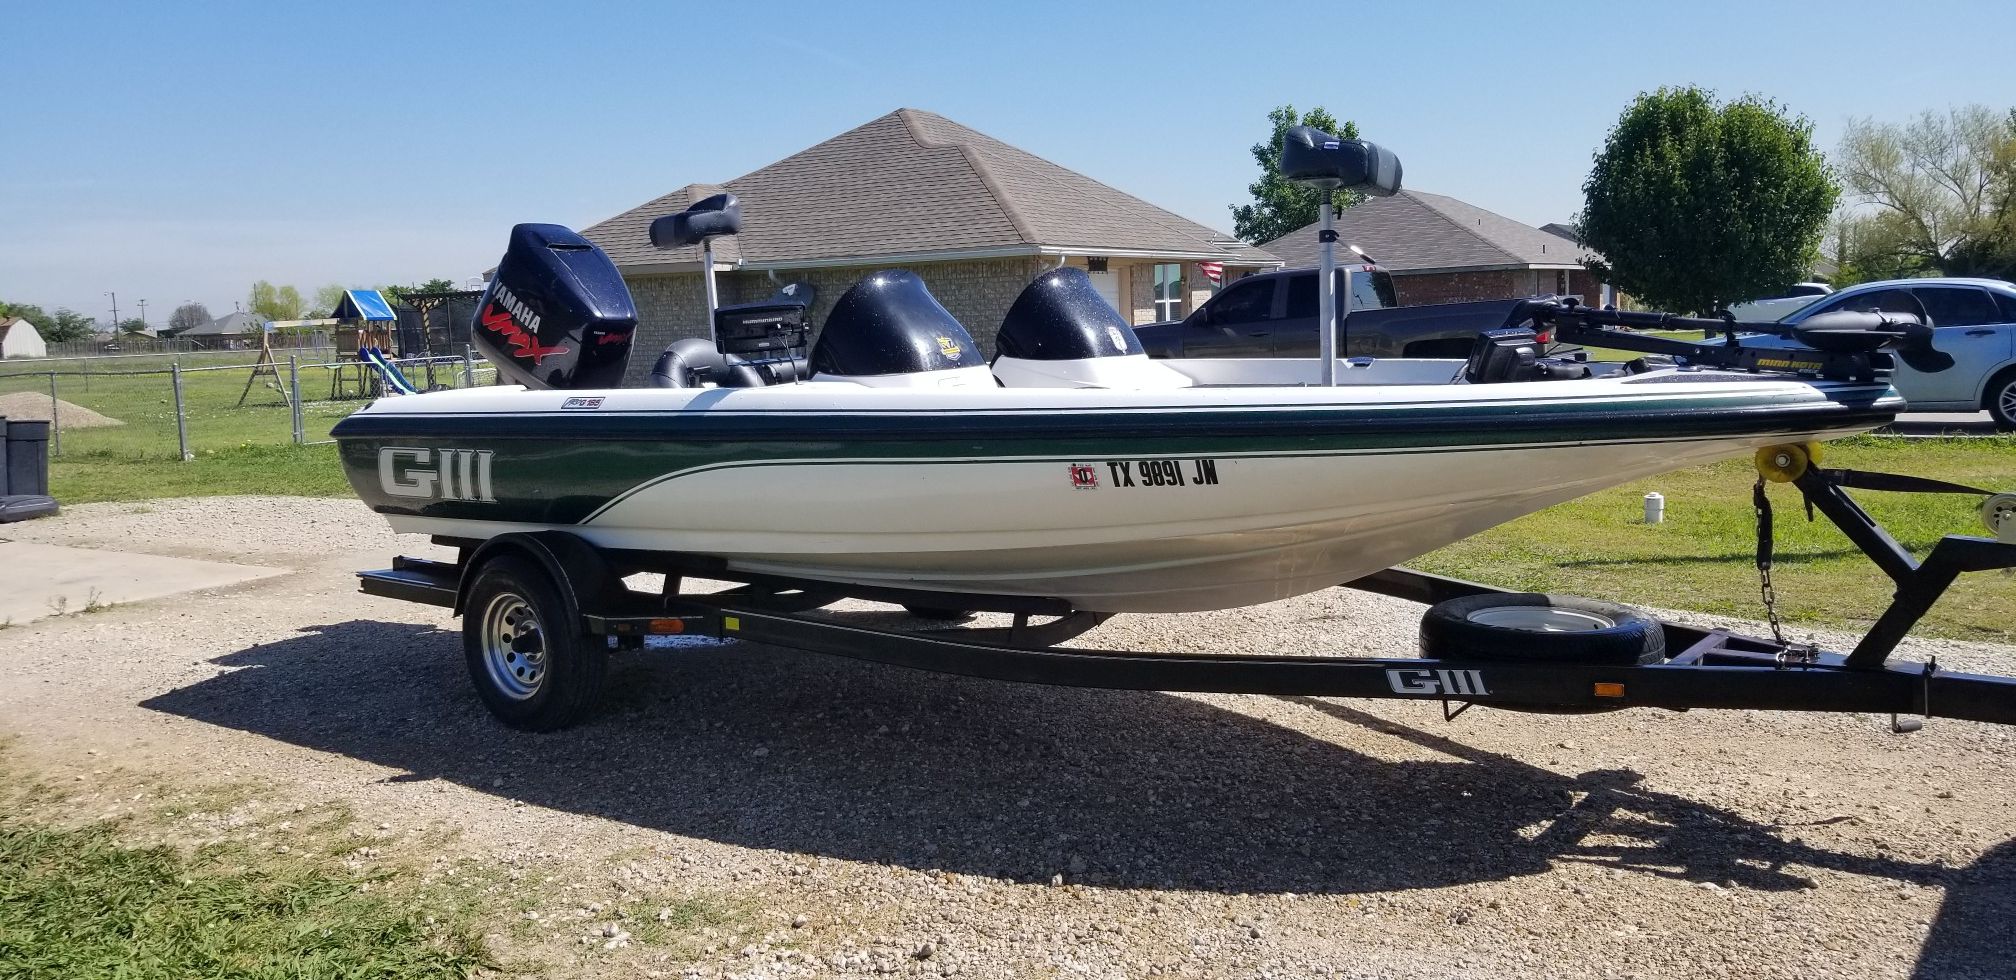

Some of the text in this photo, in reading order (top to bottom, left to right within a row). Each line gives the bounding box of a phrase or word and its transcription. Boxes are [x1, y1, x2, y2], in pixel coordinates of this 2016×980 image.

[491, 278, 542, 334] YAMAHA
[378, 446, 499, 503] GIII
[1107, 461, 1135, 487] TX
[1138, 460, 1186, 487] 9891
[1193, 459, 1219, 485] JN
[1386, 669, 1491, 696] GIII
